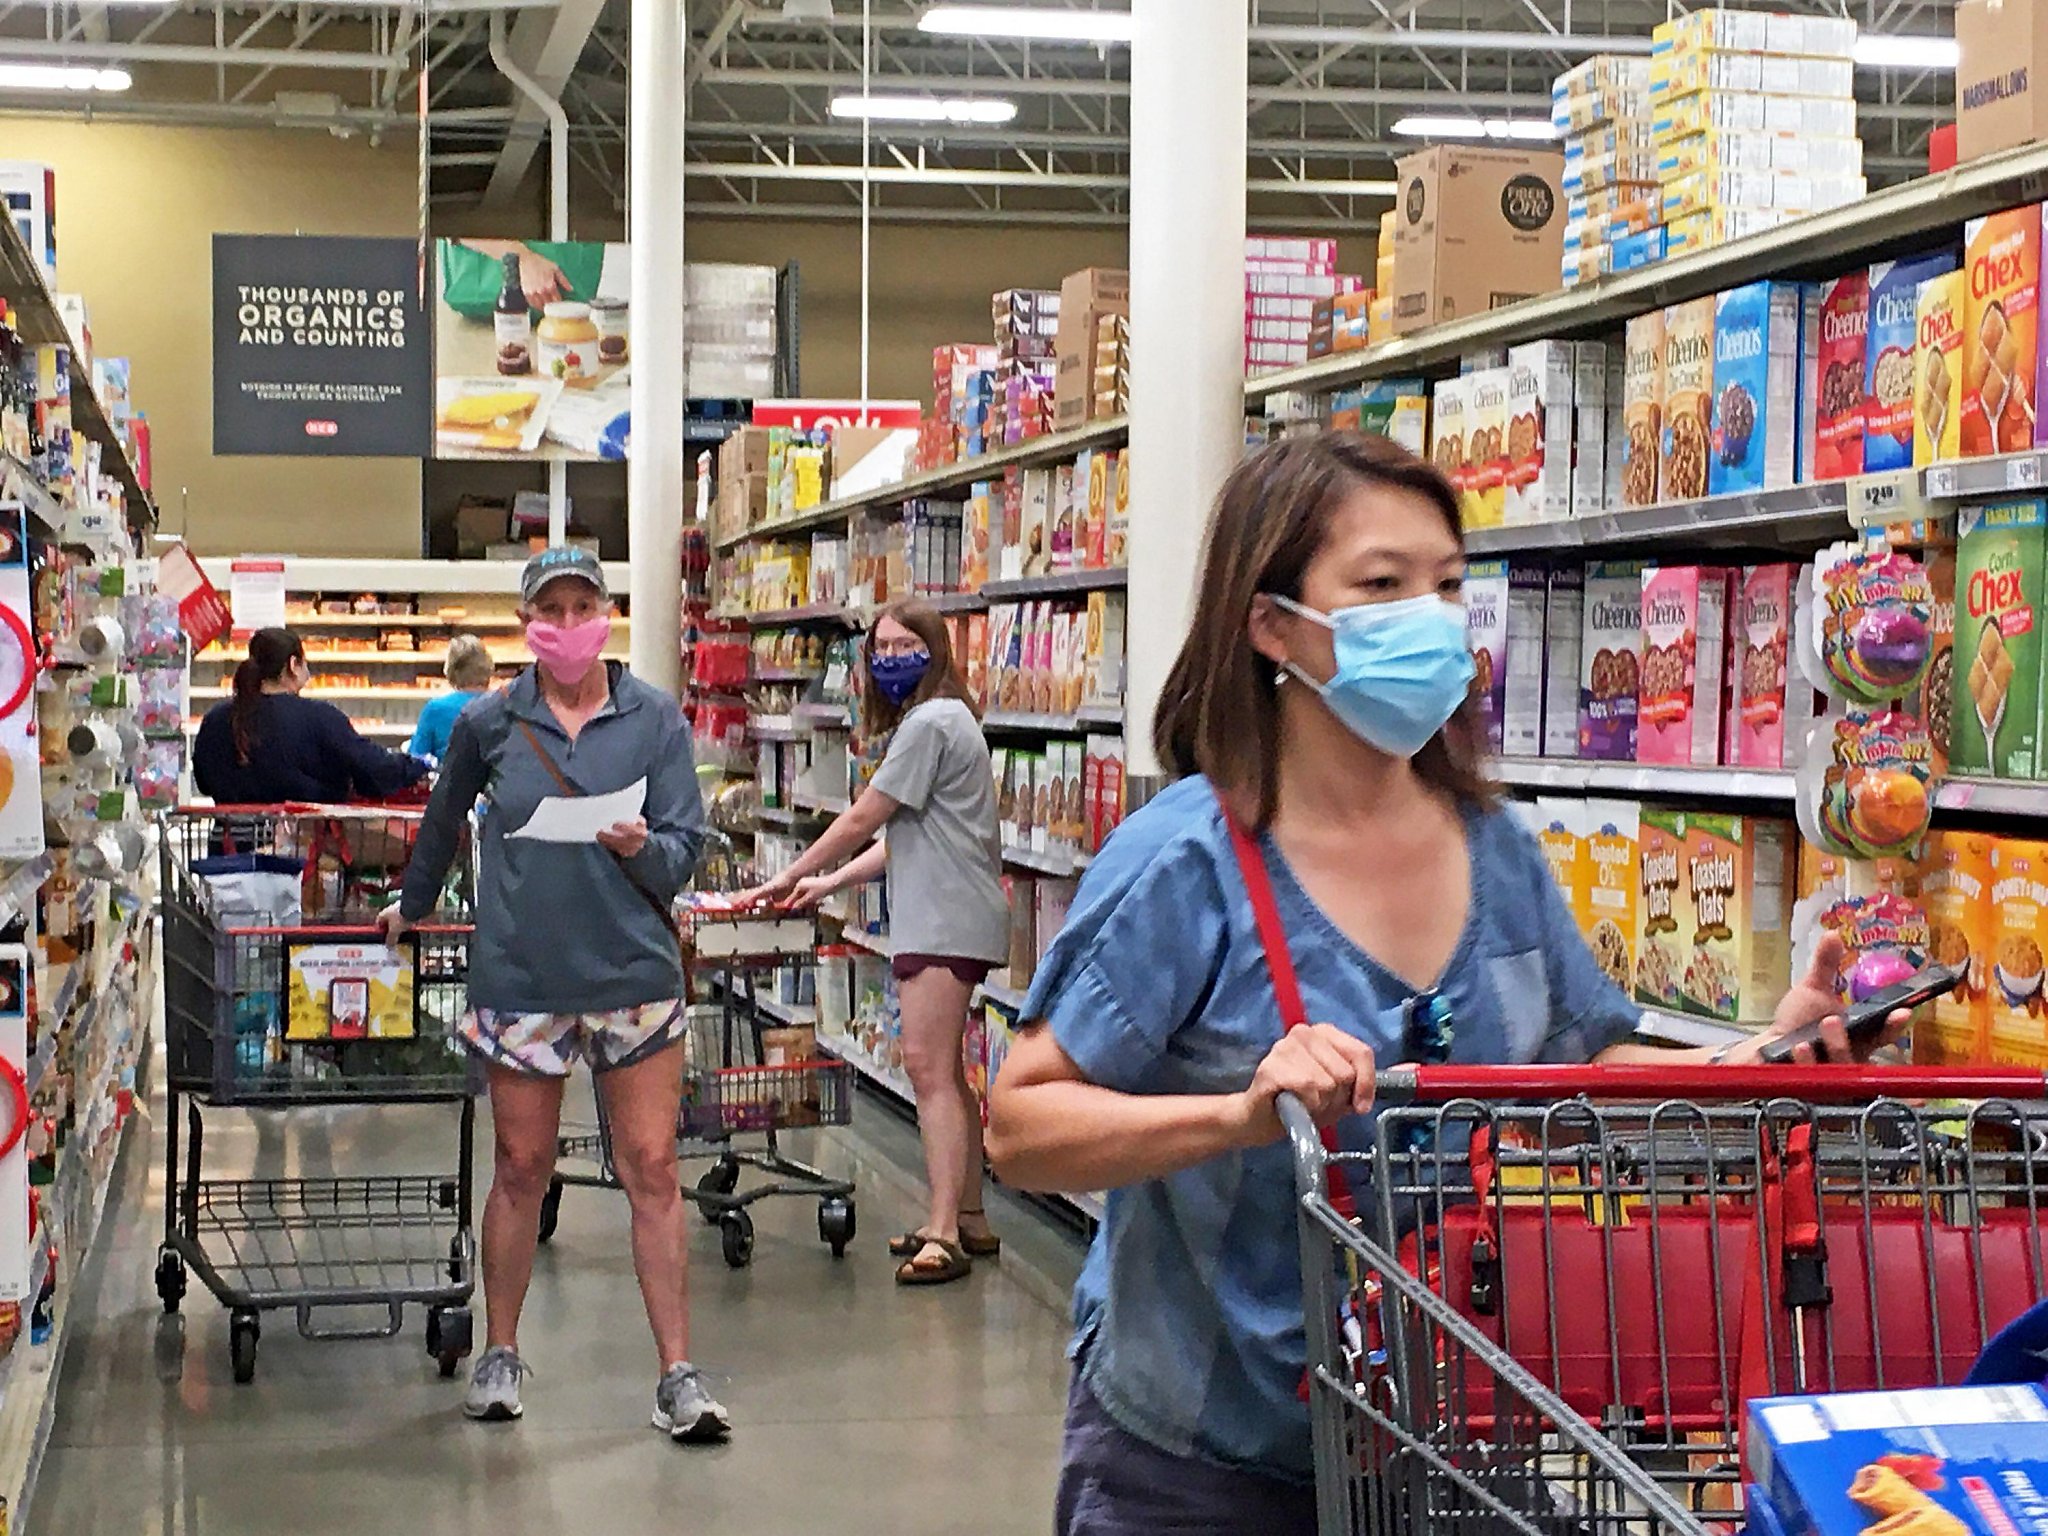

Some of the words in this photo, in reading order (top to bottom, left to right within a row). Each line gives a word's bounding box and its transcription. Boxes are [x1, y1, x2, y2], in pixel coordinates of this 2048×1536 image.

[1963, 67, 2027, 111] MARSHMALLOWS
[1971, 249, 2023, 300] Chex
[238, 286, 368, 306] THOUSANDS
[377, 290, 405, 306] OF
[1876, 292, 1916, 327] Cheer
[238, 304, 405, 331] ORGANICS
[1920, 309, 1954, 349] Chex
[238, 327, 285, 345] AND
[293, 329, 405, 348] COUNTING
[1666, 333, 1709, 368] Cheerios
[1717, 328, 1761, 362] Cheerios
[1989, 552, 2013, 574] Corn
[1968, 568, 2024, 618] Chex
[1590, 838, 1630, 866] Toasted
[1642, 848, 1678, 887] Toasted
[1690, 853, 1733, 893] Toasted
[1649, 883, 1670, 918] Oats
[1698, 889, 1725, 926] Oats
